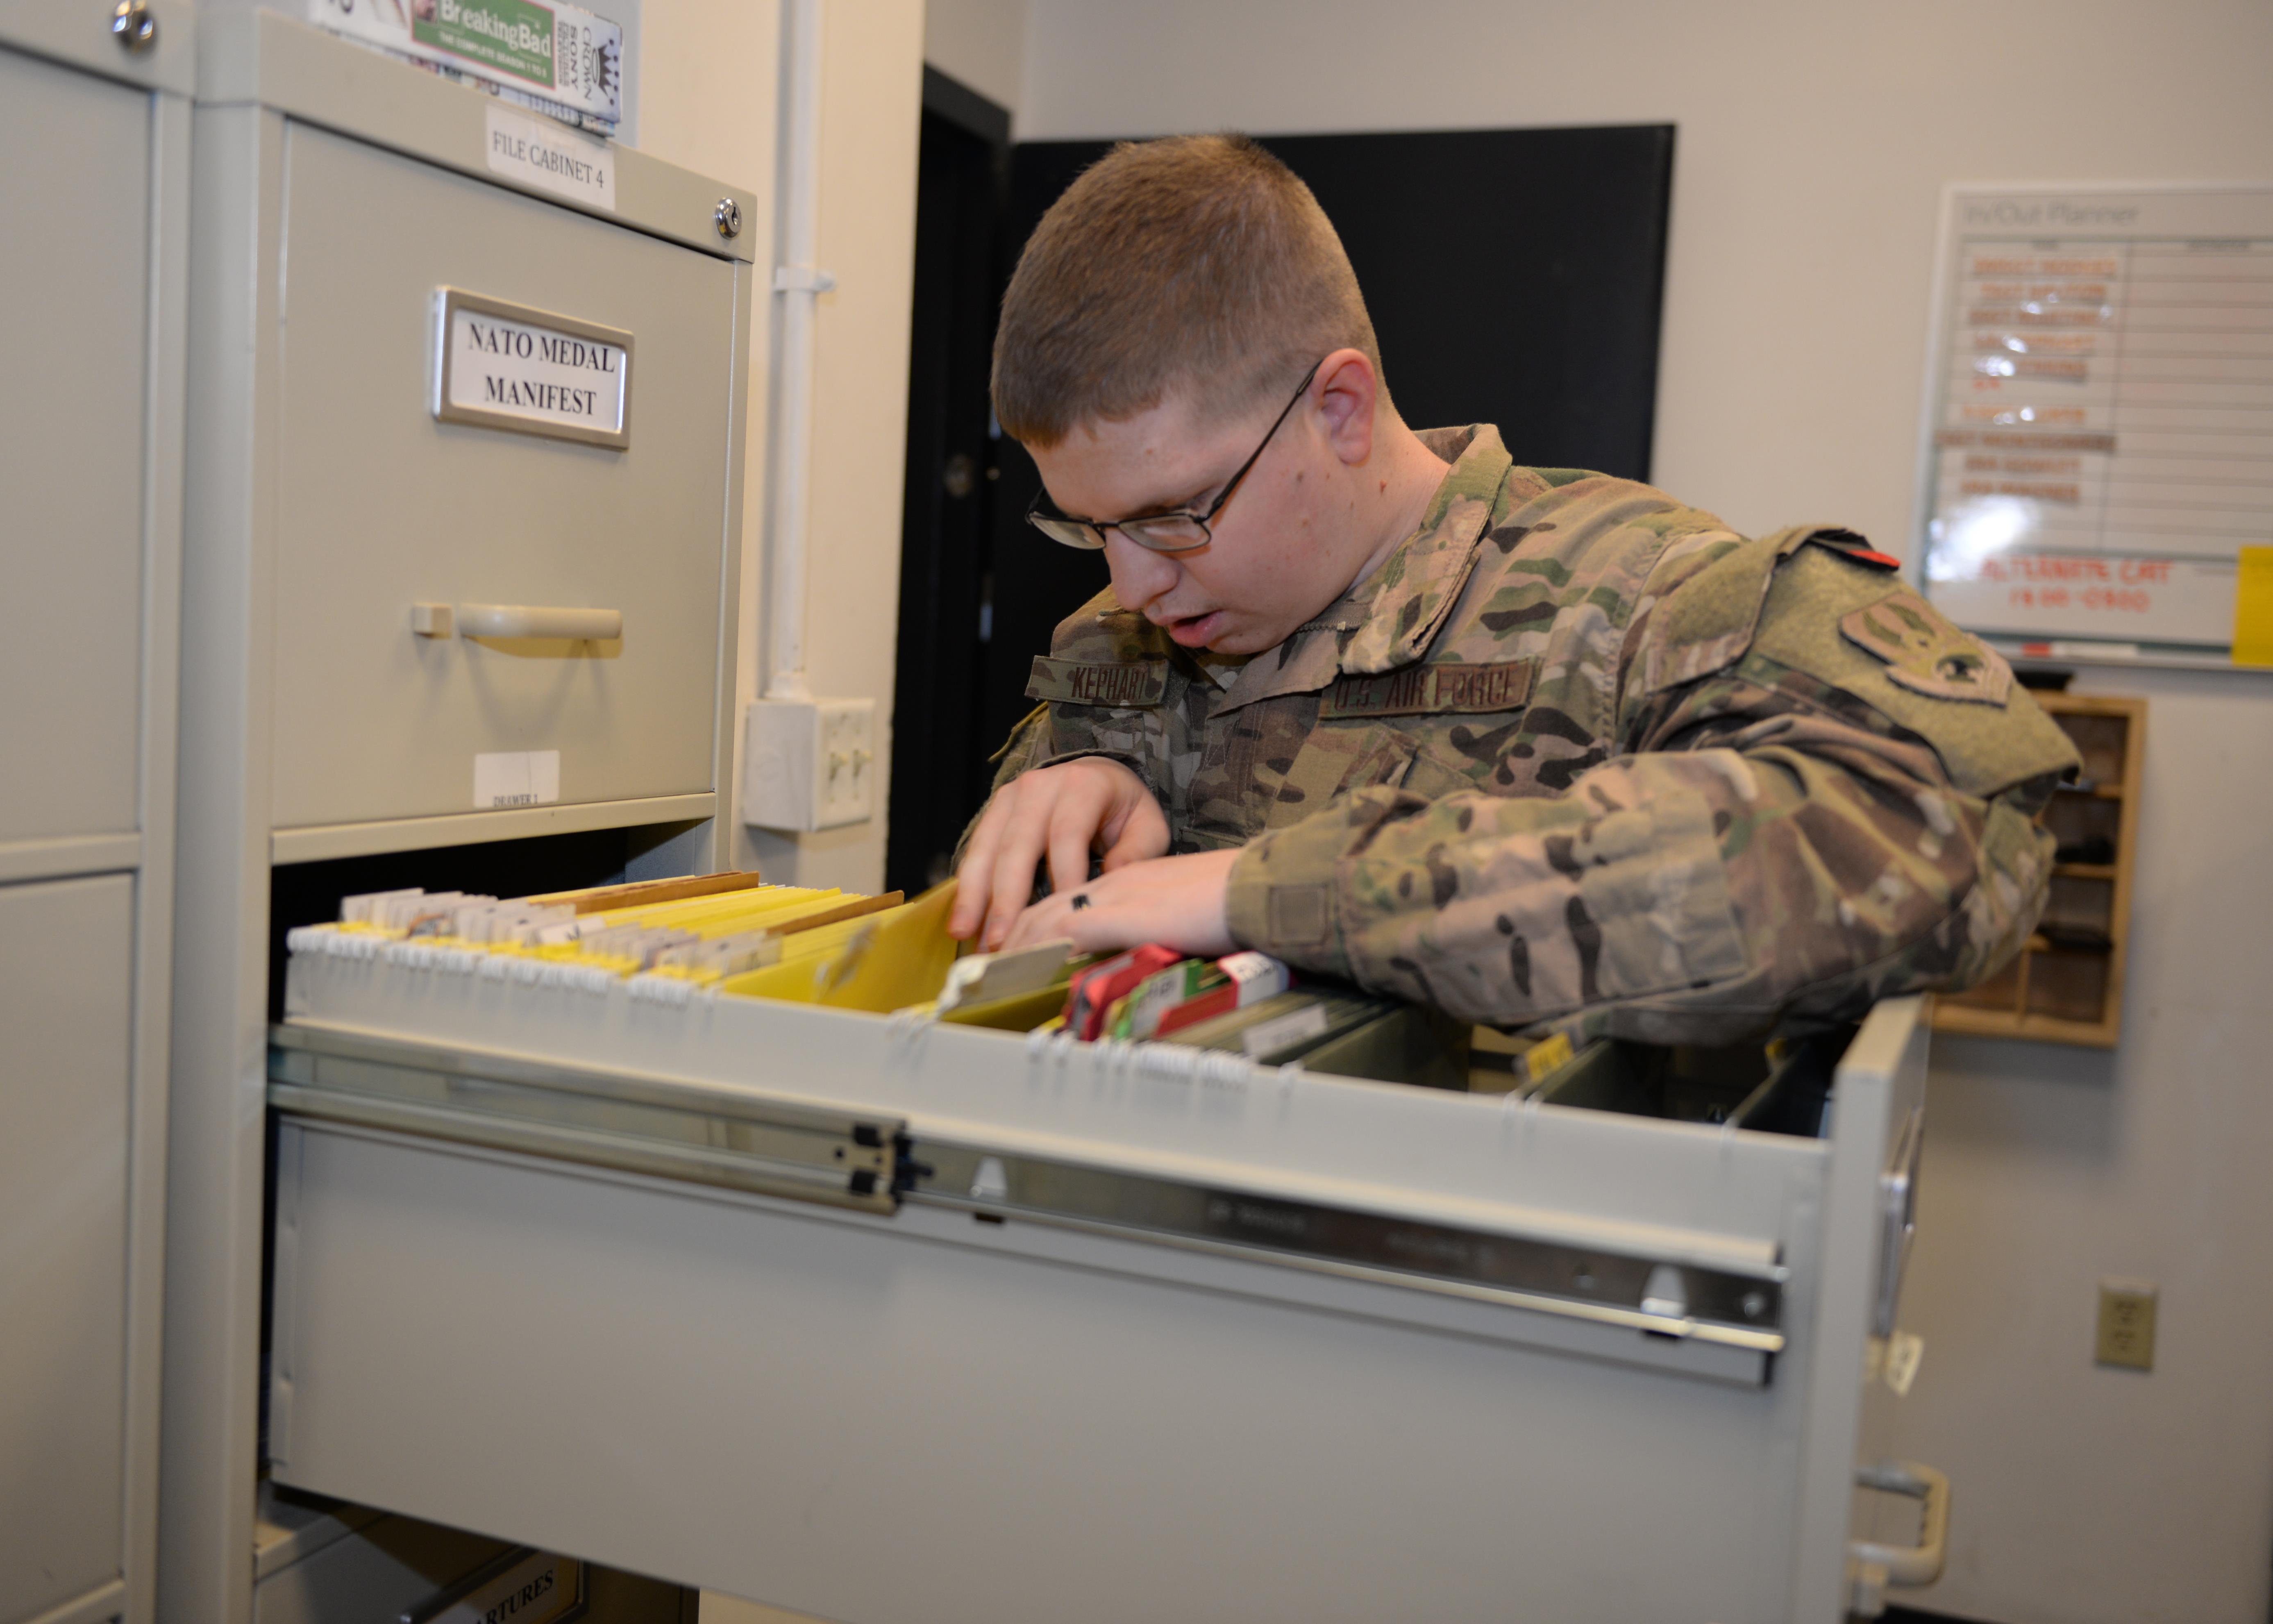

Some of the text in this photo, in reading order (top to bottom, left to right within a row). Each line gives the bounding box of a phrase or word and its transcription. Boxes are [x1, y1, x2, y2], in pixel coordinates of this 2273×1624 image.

[583, 26, 592, 100] CROWN
[493, 130, 604, 189] FILE CABINET 4
[469, 322, 615, 372] NATO MEDAL
[485, 375, 597, 415] MANIFEST
[1071, 666, 1147, 700] KEPHART
[1384, 671, 1428, 708] AIR
[1435, 666, 1518, 706] FORCE
[493, 794, 531, 807] DRAWER
